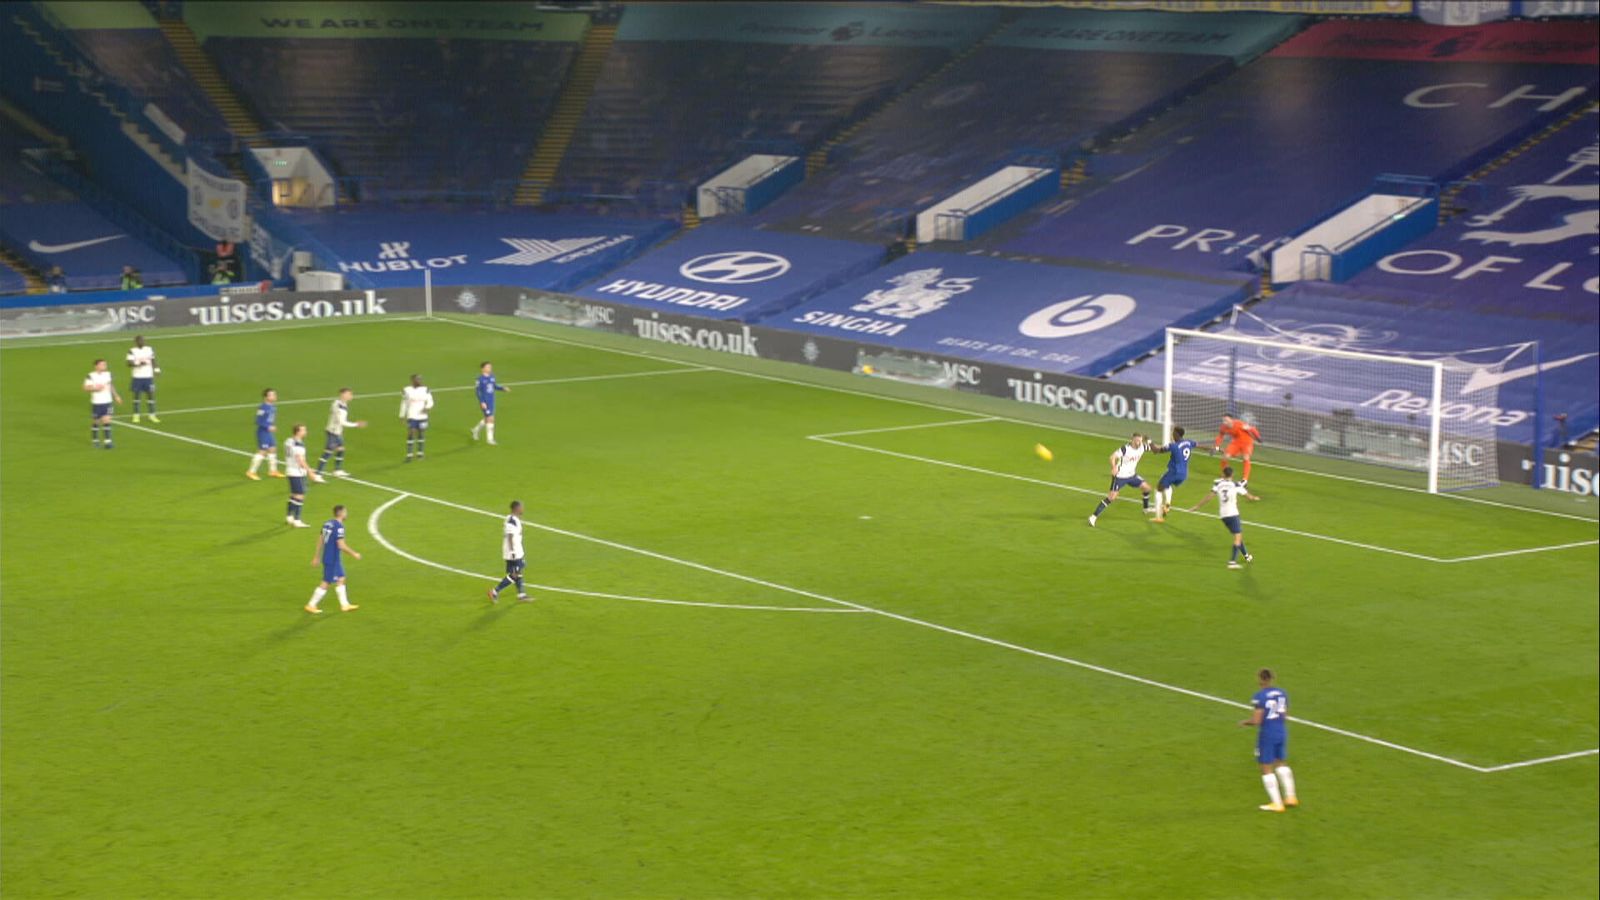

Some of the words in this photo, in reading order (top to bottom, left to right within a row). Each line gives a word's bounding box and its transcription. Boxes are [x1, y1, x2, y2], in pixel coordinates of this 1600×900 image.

[261, 18, 312, 28] WE
[320, 18, 380, 29] ARE
[387, 19, 451, 29] ONE
[462, 20, 544, 31] TEAM
[1402, 82, 1598, 113] CH
[338, 254, 467, 273] HUBLOT
[1376, 249, 1523, 280] OF
[597, 279, 748, 311] HYUNDAI
[107, 305, 155, 323] MSC
[190, 290, 387, 325] uises.co.uk
[585, 304, 615, 324] MSC
[633, 312, 758, 357] uises.co.uk
[793, 310, 907, 336] SINGHA
[942, 361, 982, 385] MSC
[1007, 372, 1165, 424] uises.co.u
[1182, 447, 1191, 461] 9
[1222, 489, 1229, 503] 3
[1265, 697, 1286, 719] 24
